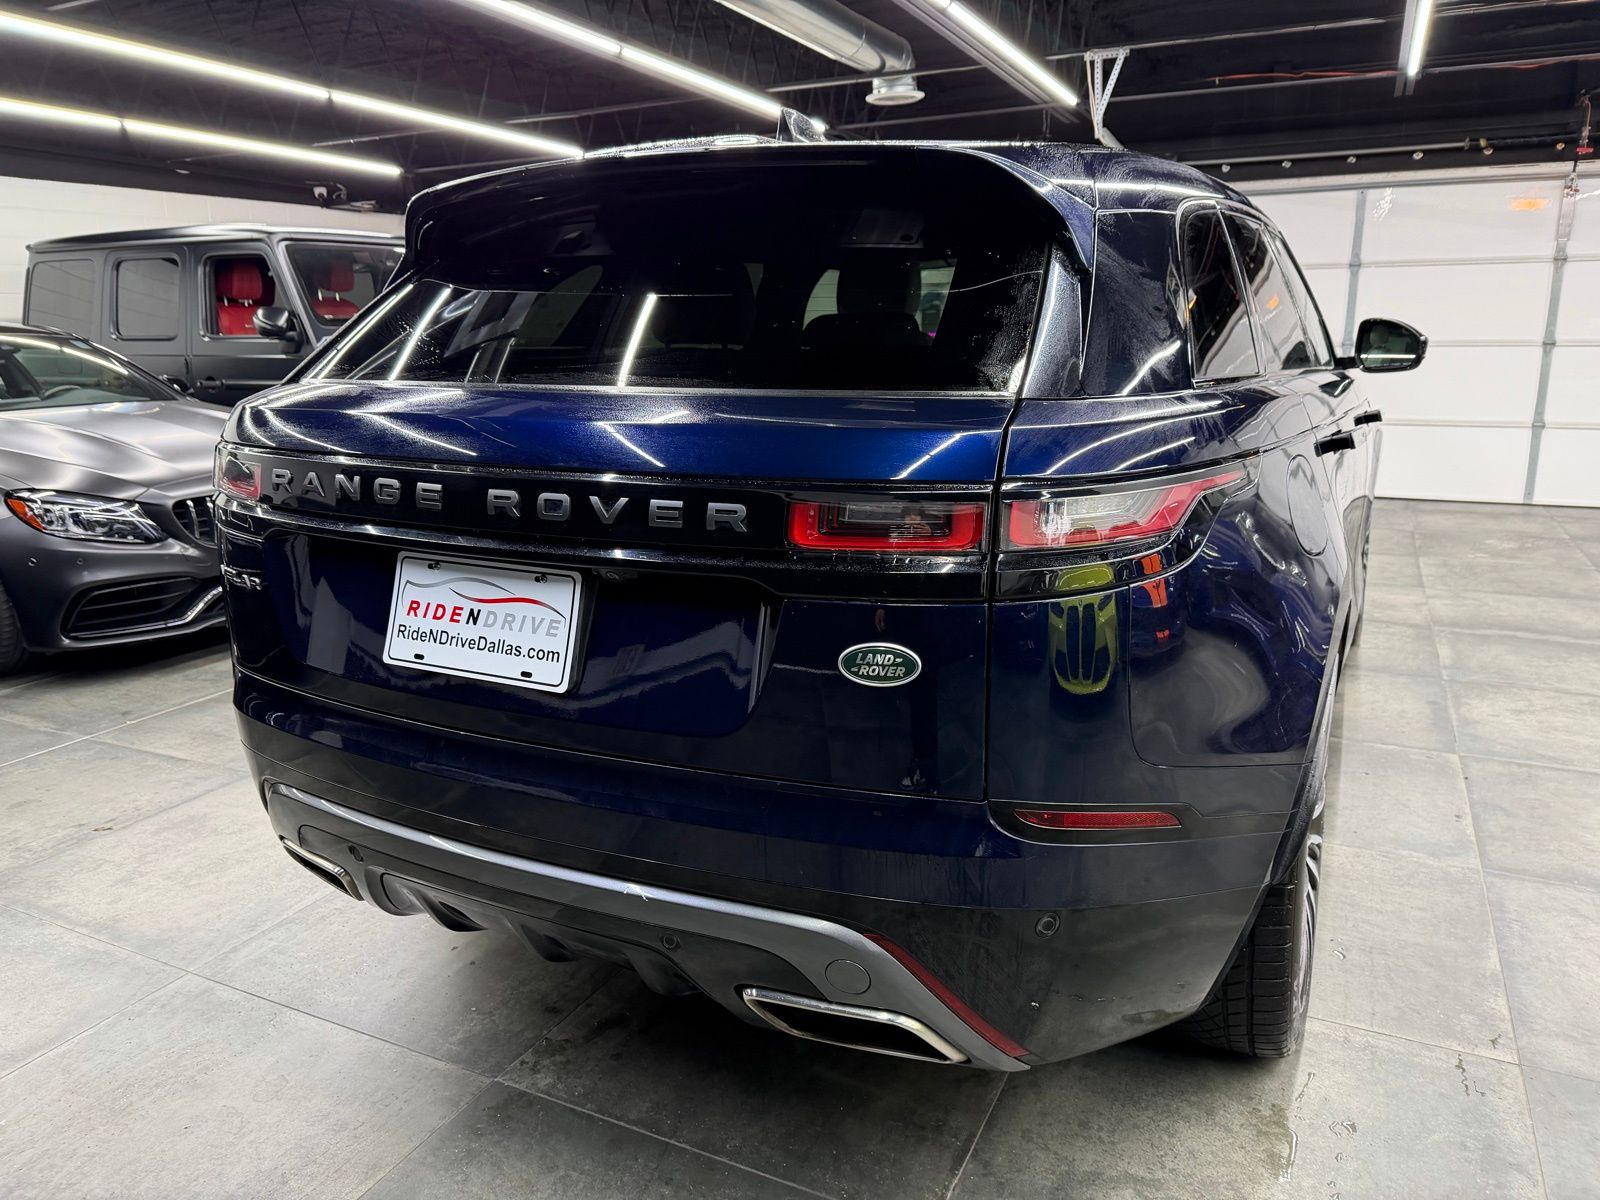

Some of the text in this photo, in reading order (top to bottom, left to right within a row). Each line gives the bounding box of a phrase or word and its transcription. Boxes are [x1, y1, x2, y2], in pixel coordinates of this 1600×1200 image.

[272, 468, 748, 532] RANGE ROVER
[397, 624, 560, 663] RideNDriveDallas.com
